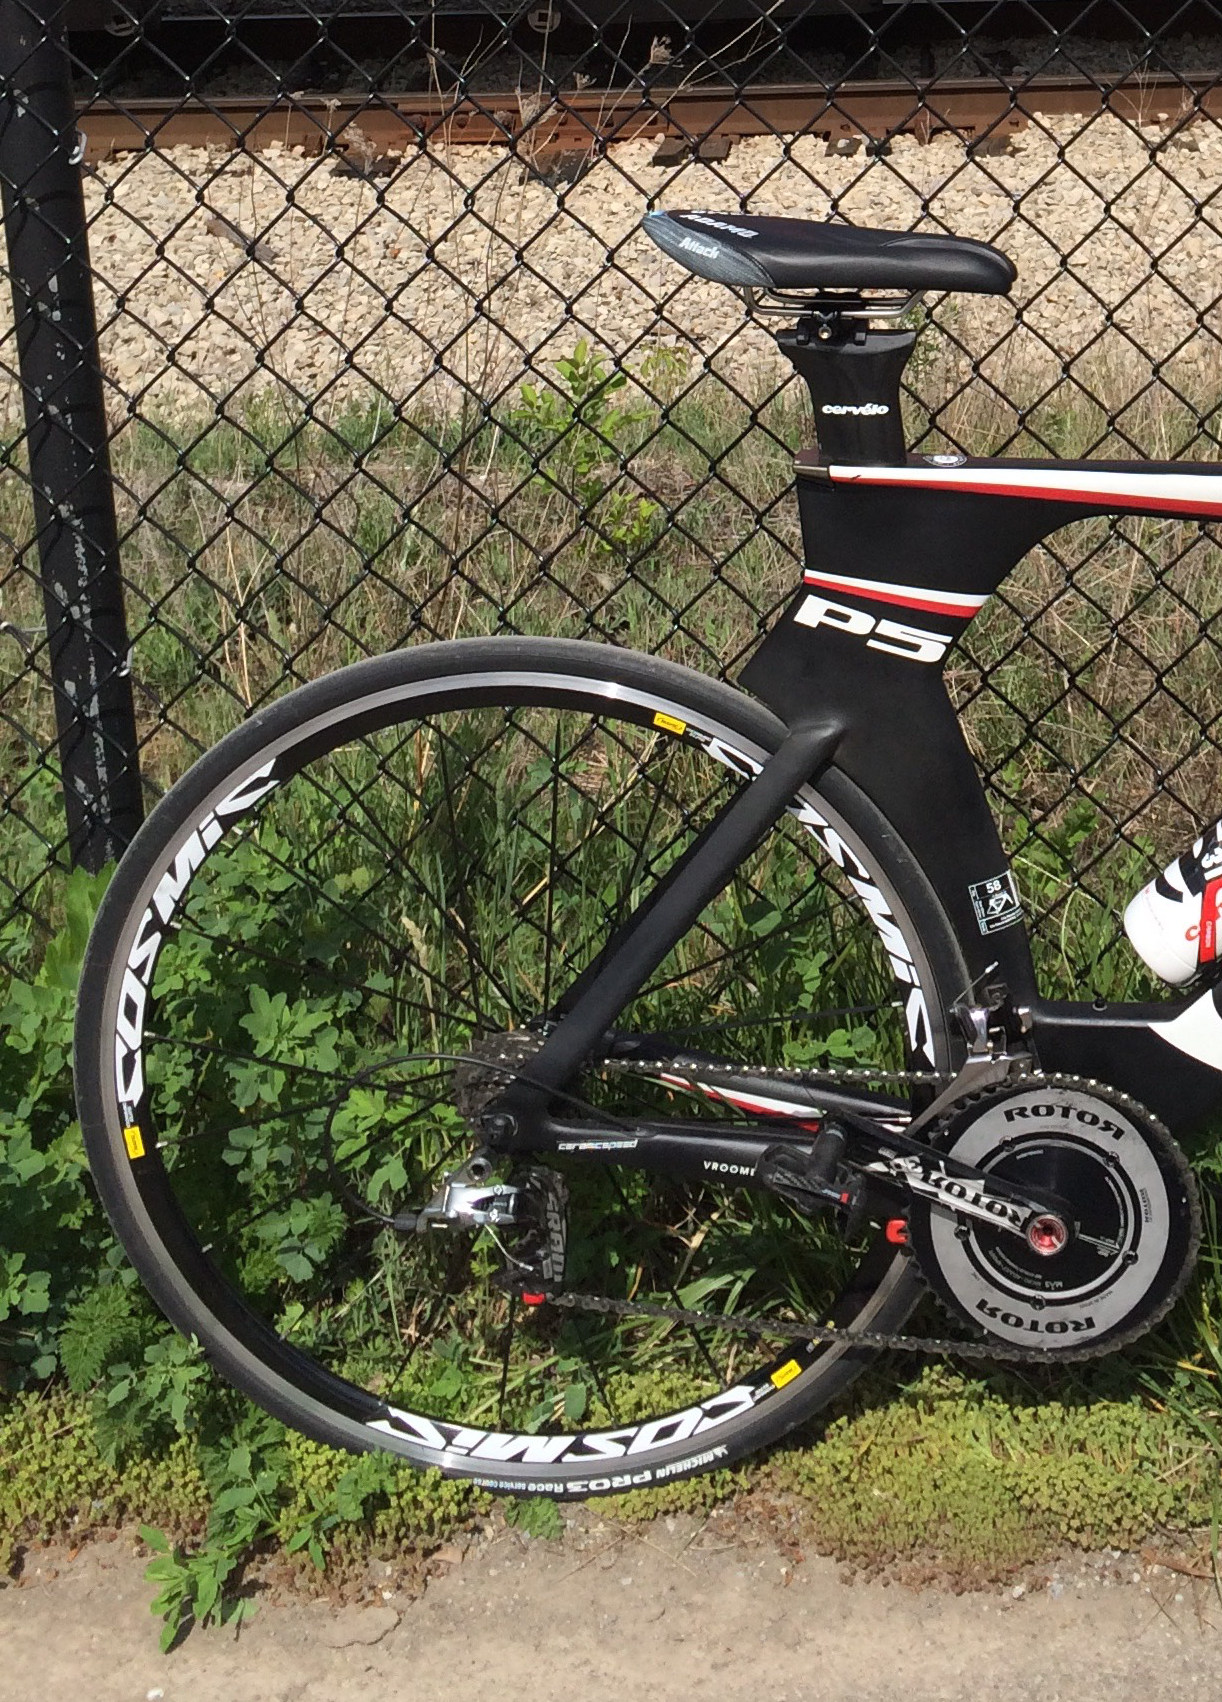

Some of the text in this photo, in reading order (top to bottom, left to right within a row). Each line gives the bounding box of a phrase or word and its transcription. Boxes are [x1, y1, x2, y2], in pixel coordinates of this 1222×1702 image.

[679, 237, 720, 259] Attack
[821, 403, 890, 416] cervélo
[793, 593, 953, 663] P5
[986, 880, 1002, 894] 58
[1003, 1103, 1126, 1141] ROTOR
[975, 1298, 1096, 1334] ROTOR
[656, 1451, 715, 1479] MICHELIN
[528, 1482, 564, 1493] Race
[566, 1470, 652, 1493] PRO3
